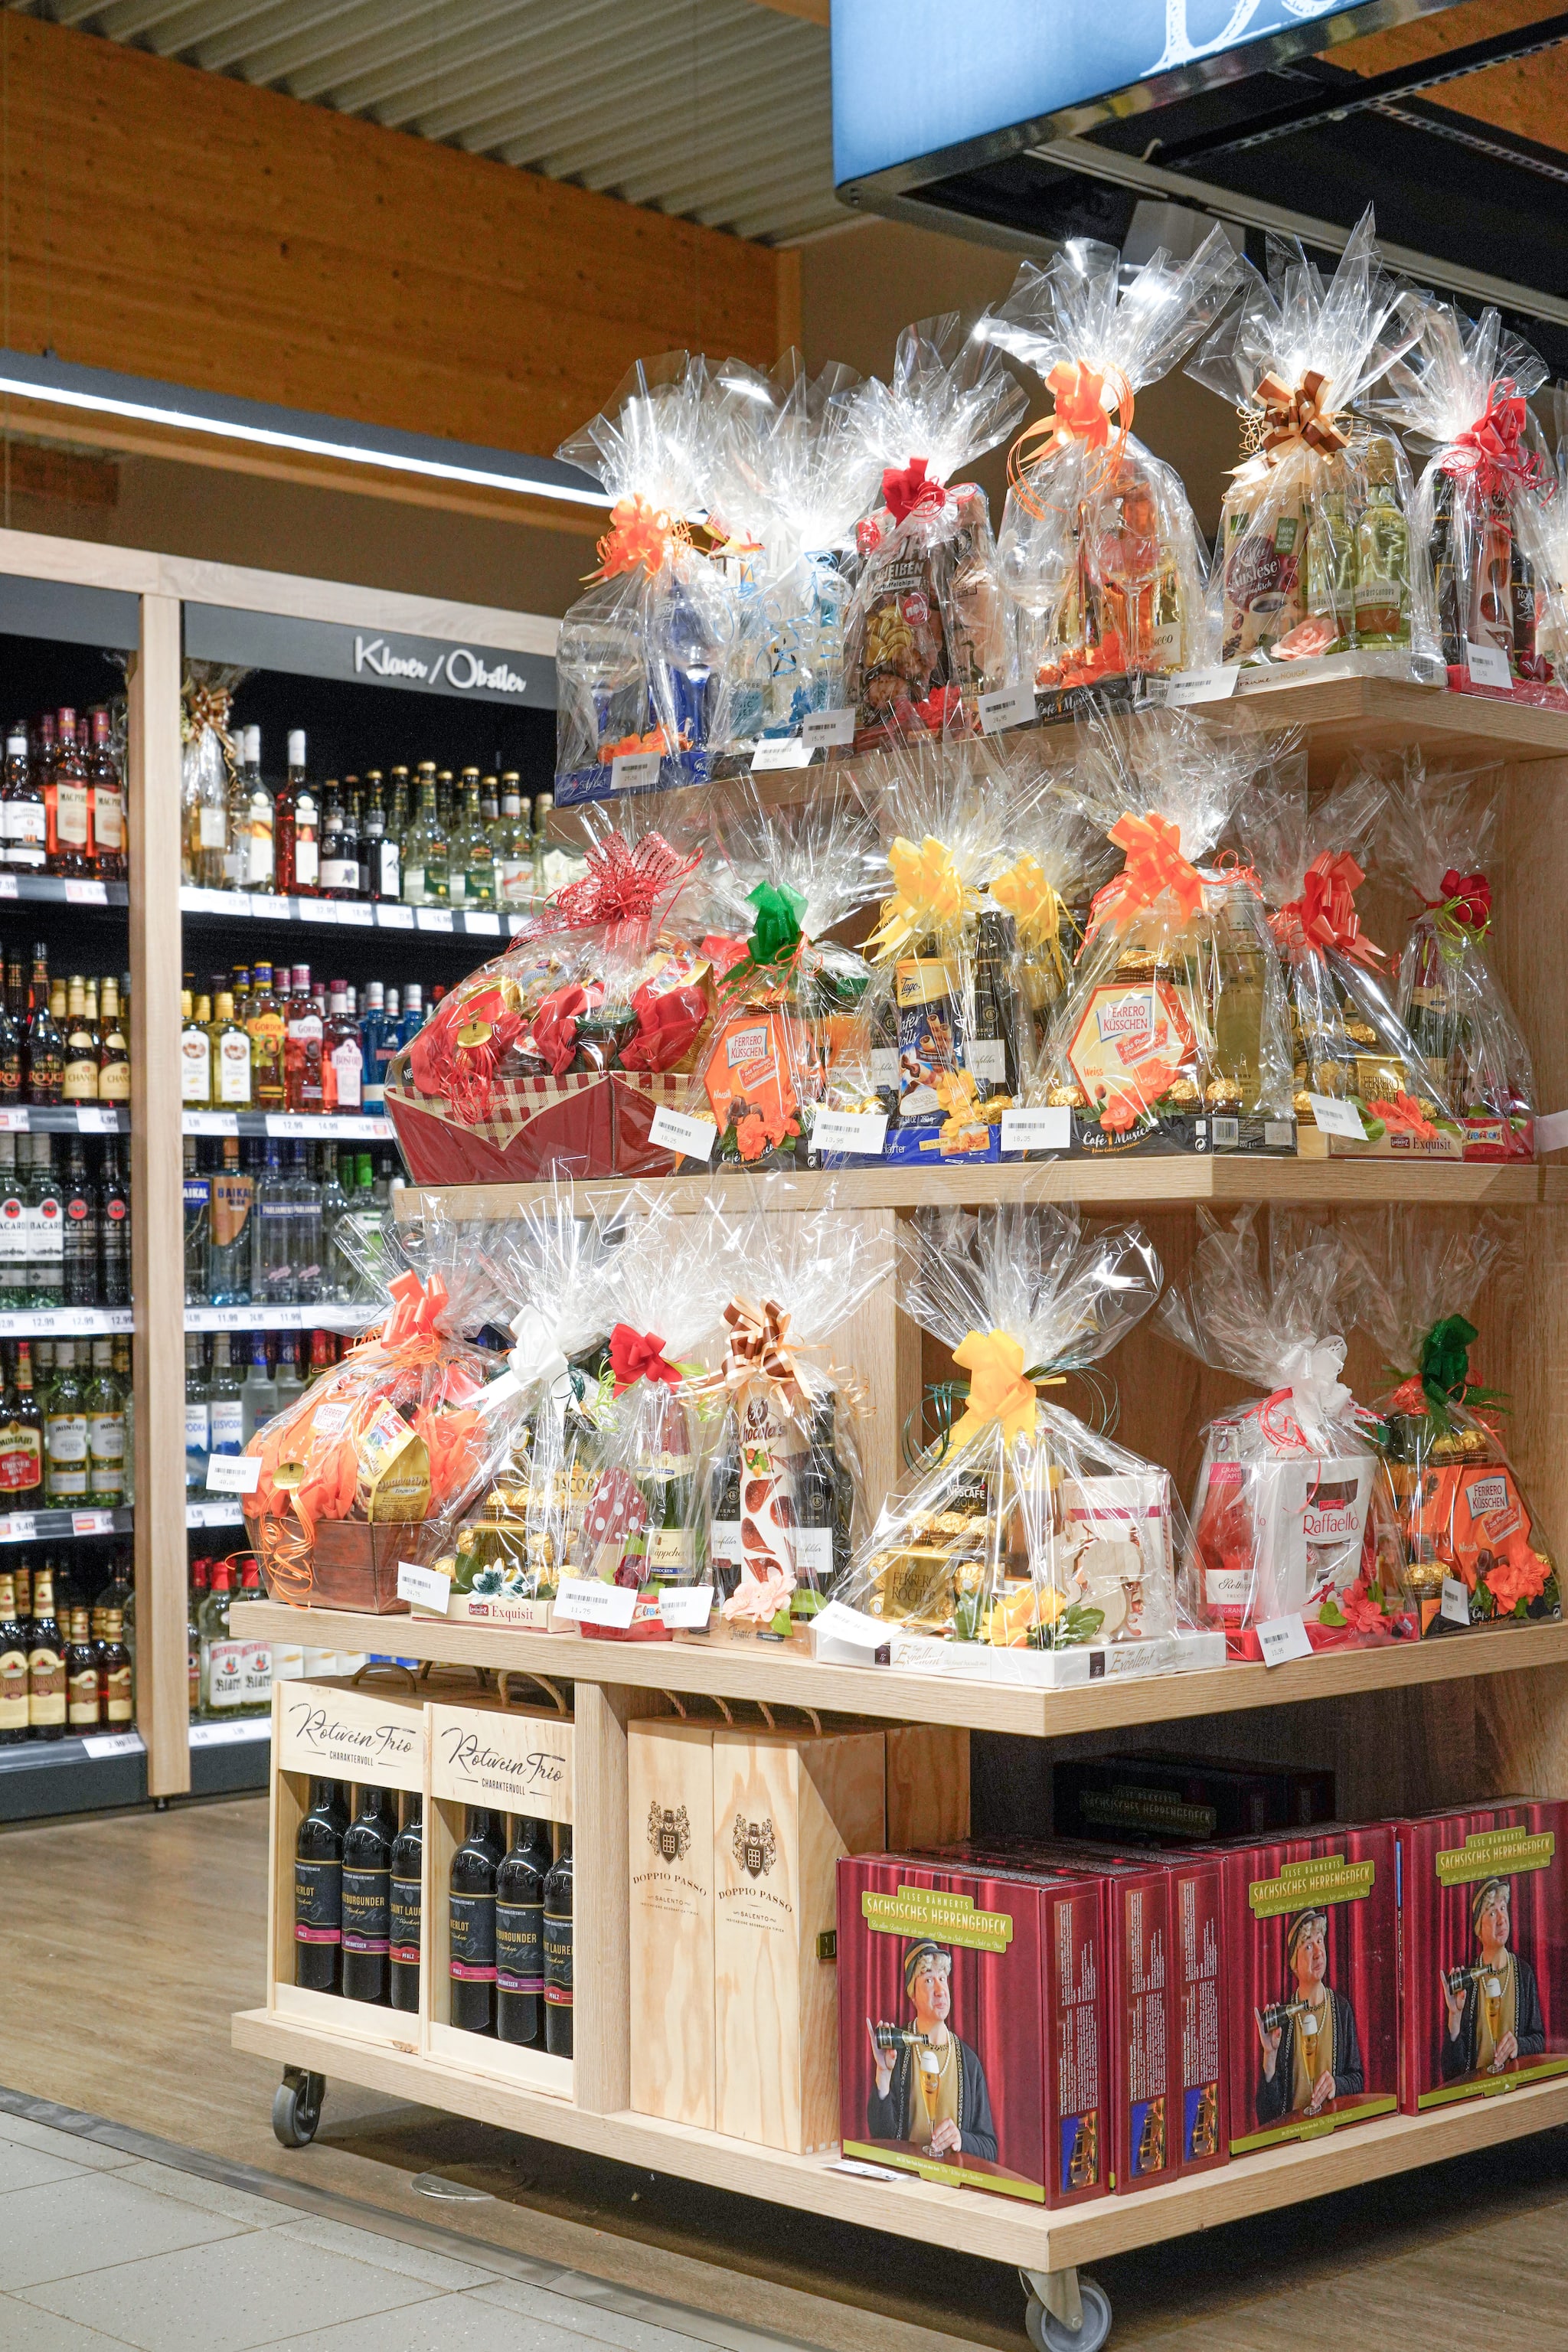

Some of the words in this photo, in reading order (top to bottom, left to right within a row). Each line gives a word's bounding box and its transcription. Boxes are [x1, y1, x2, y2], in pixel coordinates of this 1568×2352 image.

[1279, 526, 1294, 534] 100%
[1280, 670, 1308, 681] NOUGAT
[900, 978, 921, 997] Tago
[1107, 1005, 1145, 1020] FERRERO
[900, 1011, 923, 1034] afer
[1103, 1017, 1148, 1031] KÜSSCHEN
[734, 1035, 763, 1047] FERRERO
[898, 1030, 920, 1049] olls
[730, 1046, 763, 1059] KÜSSCHEN
[1083, 1066, 1103, 1077] Weiss
[714, 1089, 731, 1099] Klassik
[283, 1121, 302, 1130] 12.99
[319, 1122, 338, 1131] 14.99
[825, 1136, 844, 1145] 13.95
[1083, 1131, 1105, 1149] Café
[1413, 1138, 1451, 1154] Exquisit
[184, 1187, 208, 1199] AIKAL
[0, 1221, 25, 1230] ACARD
[30, 1221, 62, 1230] BACARD
[32, 1317, 54, 1327] 12.99
[554, 1478, 595, 1493] JACOB
[1474, 1485, 1501, 1497] FERRERO
[1472, 1497, 1505, 1509] KÜSSCHEN
[1303, 1512, 1359, 1537] Raffaello
[492, 1606, 534, 1620] Exquisit
[571, 1606, 591, 1615] 11.75
[1108, 1649, 1154, 1675] Excellent
[289, 1703, 376, 1746] Rotwein
[376, 1726, 416, 1755] Trio
[329, 1750, 374, 1766] CHARAKTERVOLL
[441, 1727, 527, 1774] Rotwein
[527, 1753, 566, 1783] Trio
[482, 1777, 526, 1795] CHARAKTERVOLL
[1470, 1839, 1485, 1847] ILSE
[1488, 1832, 1522, 1845] BÄHNERTS
[1493, 1838, 1550, 1861] HERRENGEDECK
[1285, 1867, 1301, 1878] ILSE
[1305, 1860, 1341, 1874] BÄHNERTS
[632, 1872, 671, 1884] DOPPIO
[675, 1875, 707, 1896] PASSO
[1254, 1877, 1307, 1903] SÄCHSISCHES
[1309, 1867, 1370, 1892] HERRENGEDECK
[655, 1895, 684, 1906] SALENTO
[718, 1888, 756, 1900] DOPPIO
[760, 1891, 792, 1913] PASSO
[903, 1892, 921, 1902] ILSE
[926, 1894, 969, 1910] BÄHNERTS
[403, 1906, 421, 1916] LAUR
[740, 1911, 769, 1922] SALENTO
[867, 1895, 928, 1924] SÄCHSISCHES
[931, 1909, 1007, 1937] HERRENGEDECK
[550, 1944, 573, 1955] LAURE
